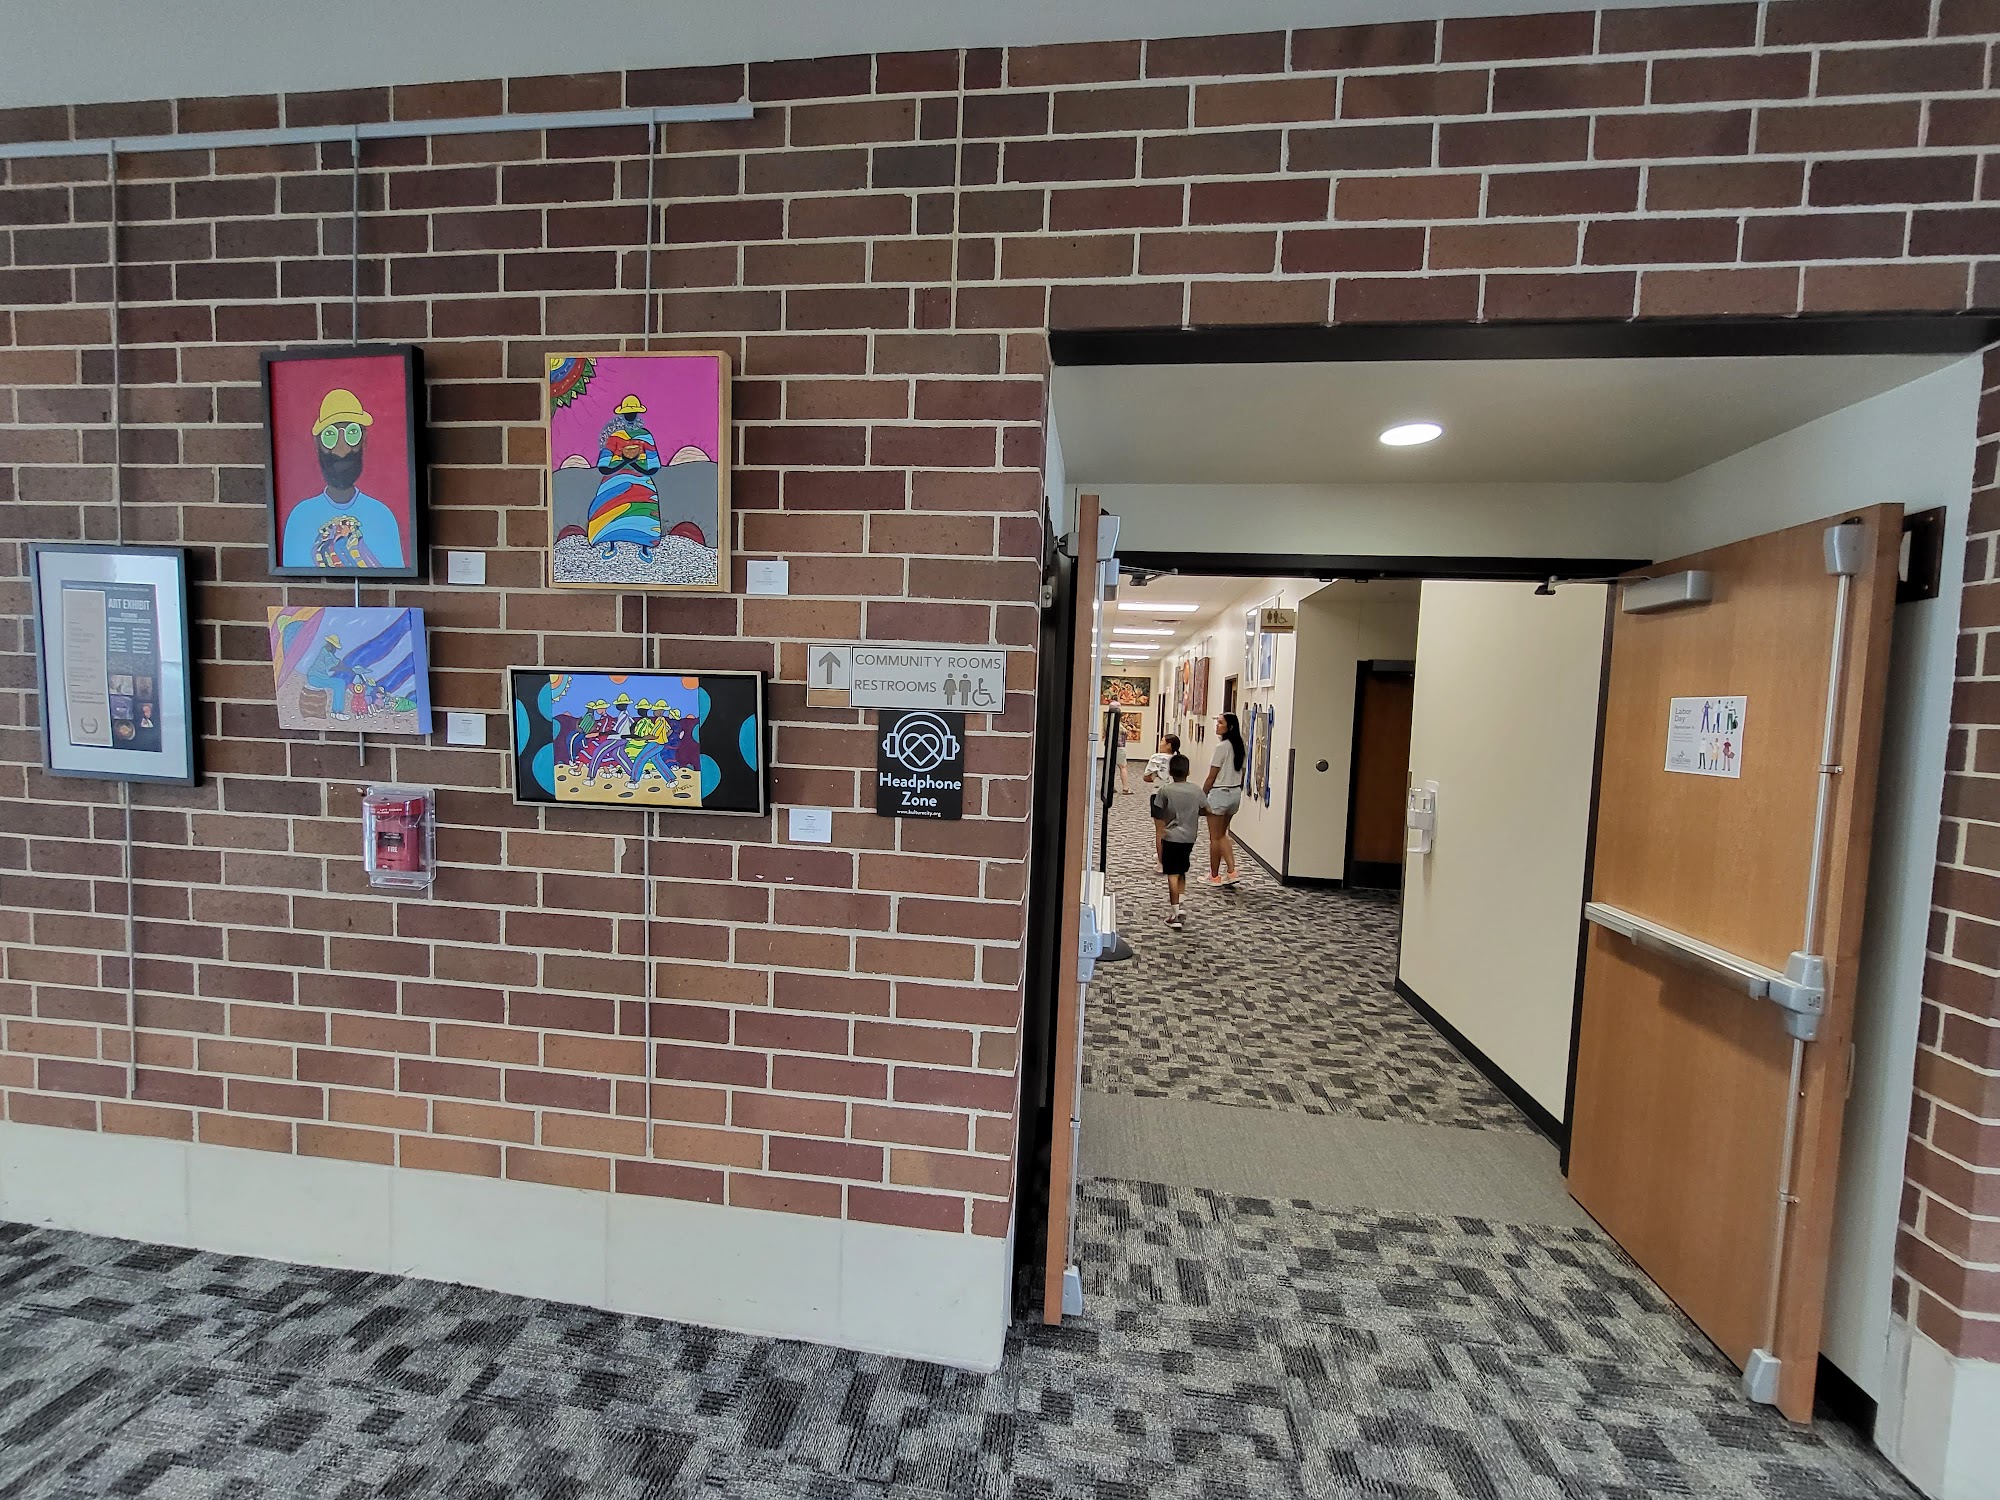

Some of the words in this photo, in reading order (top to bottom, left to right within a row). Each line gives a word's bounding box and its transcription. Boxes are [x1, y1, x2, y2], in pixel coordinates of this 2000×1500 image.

[108, 598, 121, 609] ART
[123, 599, 151, 611] EXHIBIT
[855, 654, 943, 668] COMMUNITY
[948, 657, 1001, 670] ROOMS
[854, 679, 937, 693] RESTROOMS
[1675, 707, 1692, 715] Labor
[1674, 715, 1686, 724] Day
[879, 772, 962, 793] Headphone
[901, 791, 938, 807] Zone
[387, 845, 398, 853] FIRE
